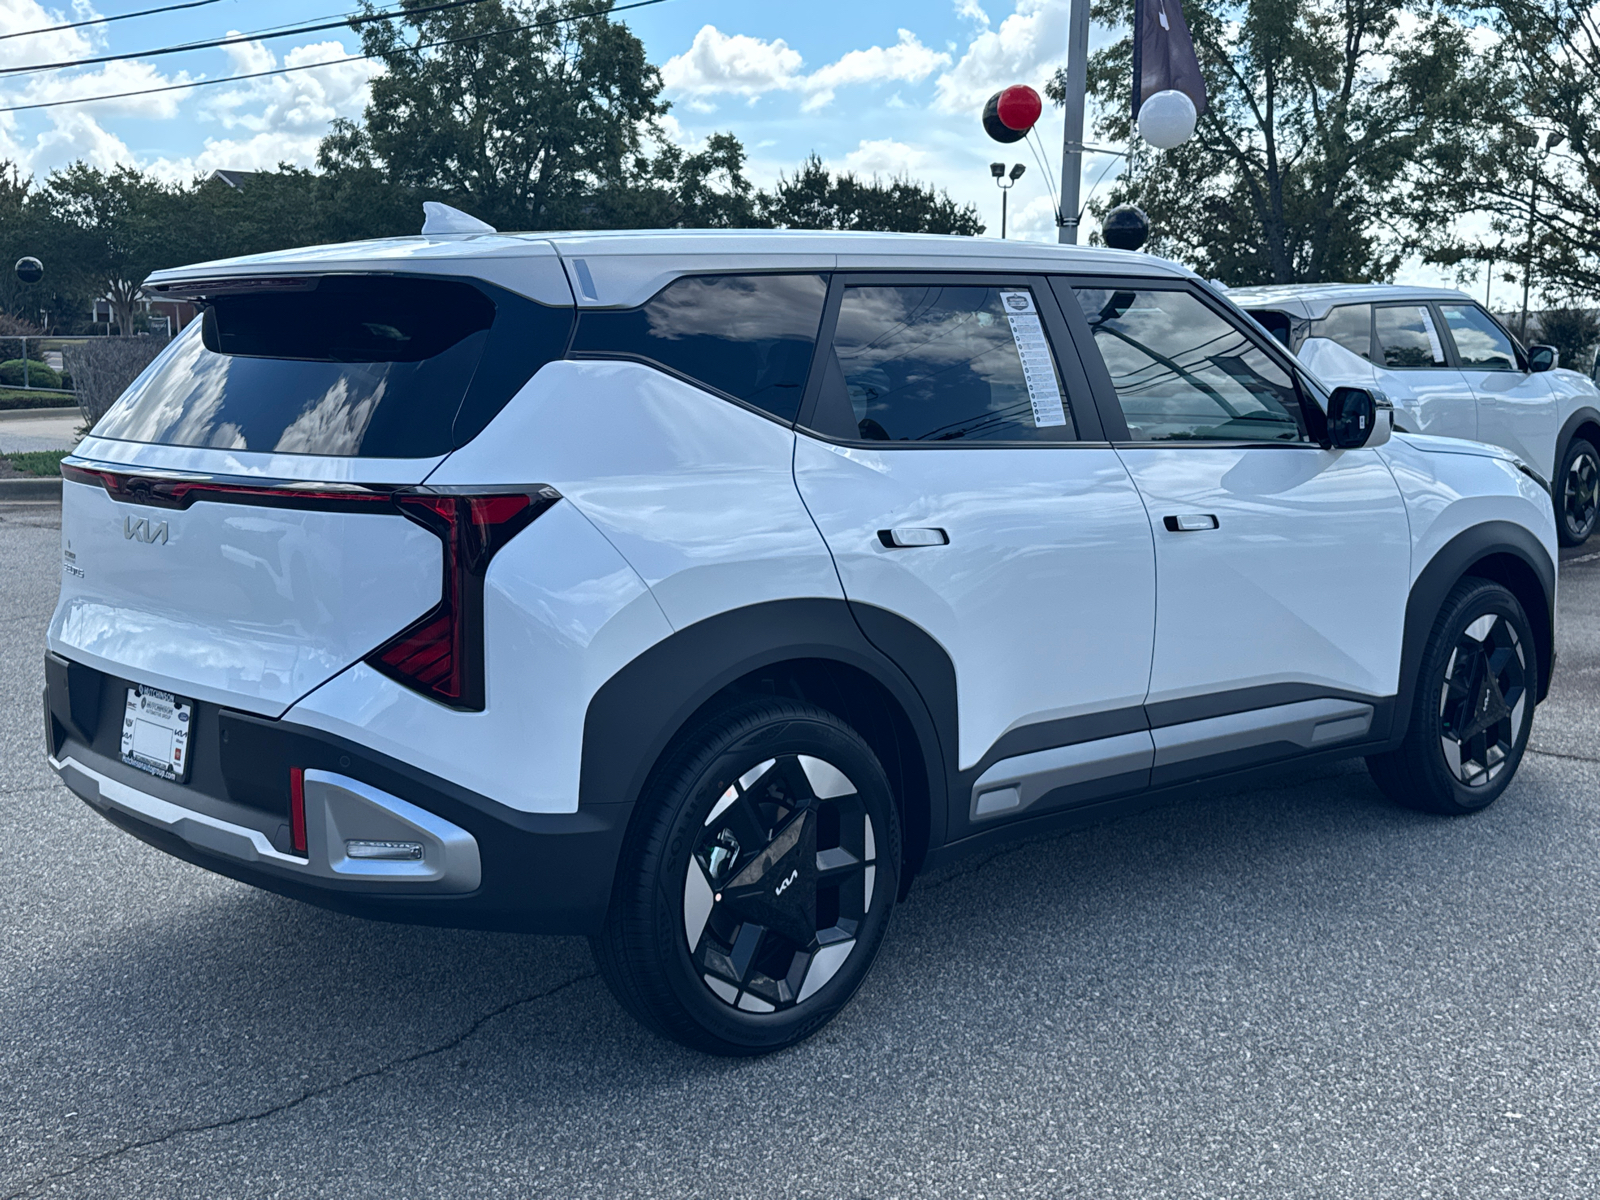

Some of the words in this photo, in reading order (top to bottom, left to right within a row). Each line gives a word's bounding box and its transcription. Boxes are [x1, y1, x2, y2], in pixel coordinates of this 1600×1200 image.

[124, 516, 169, 546] KIA
[143, 686, 176, 703] HUTCHINSON
[1430, 687, 1440, 750] KUMHO
[667, 787, 708, 873] SOLUS
[775, 869, 798, 896] KIA
